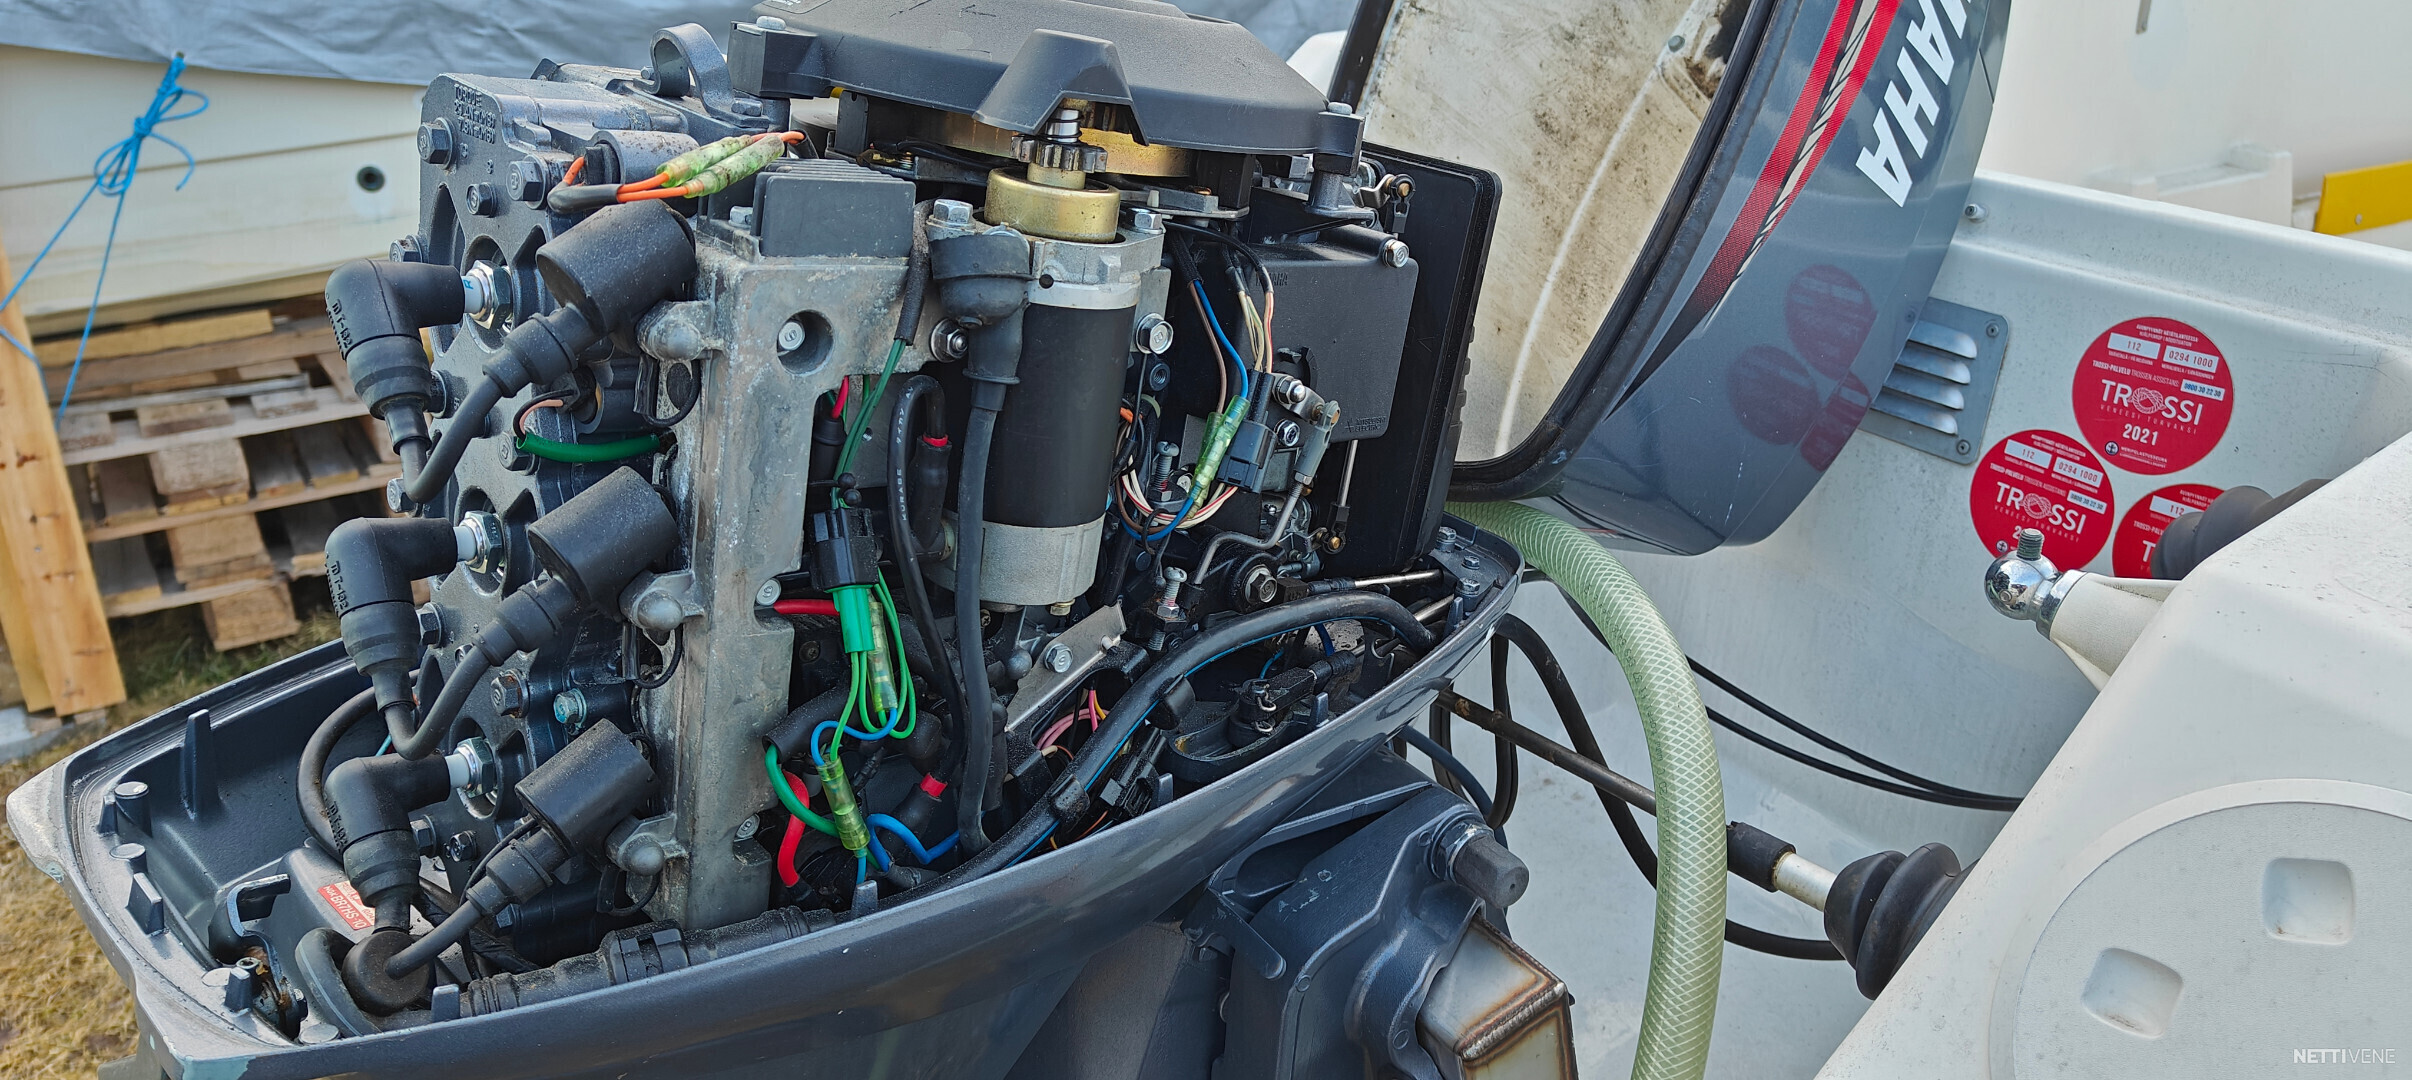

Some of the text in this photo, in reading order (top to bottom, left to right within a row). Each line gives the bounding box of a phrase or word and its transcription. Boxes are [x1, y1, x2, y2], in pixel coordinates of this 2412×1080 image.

[2127, 340, 2142, 352] 112
[2168, 350, 2213, 368] 0294 1000
[2101, 379, 2203, 426] TROSSI
[2122, 423, 2158, 446] 2021
[2022, 448, 2035, 459] 112
[2058, 461, 2077, 475] 0294
[2080, 468, 2098, 483] 1000
[896, 468, 907, 521] KURABE
[1996, 481, 2087, 535] TROSSI
[2170, 504, 2185, 516] 112
[330, 895, 367, 928] BR7HS-10
